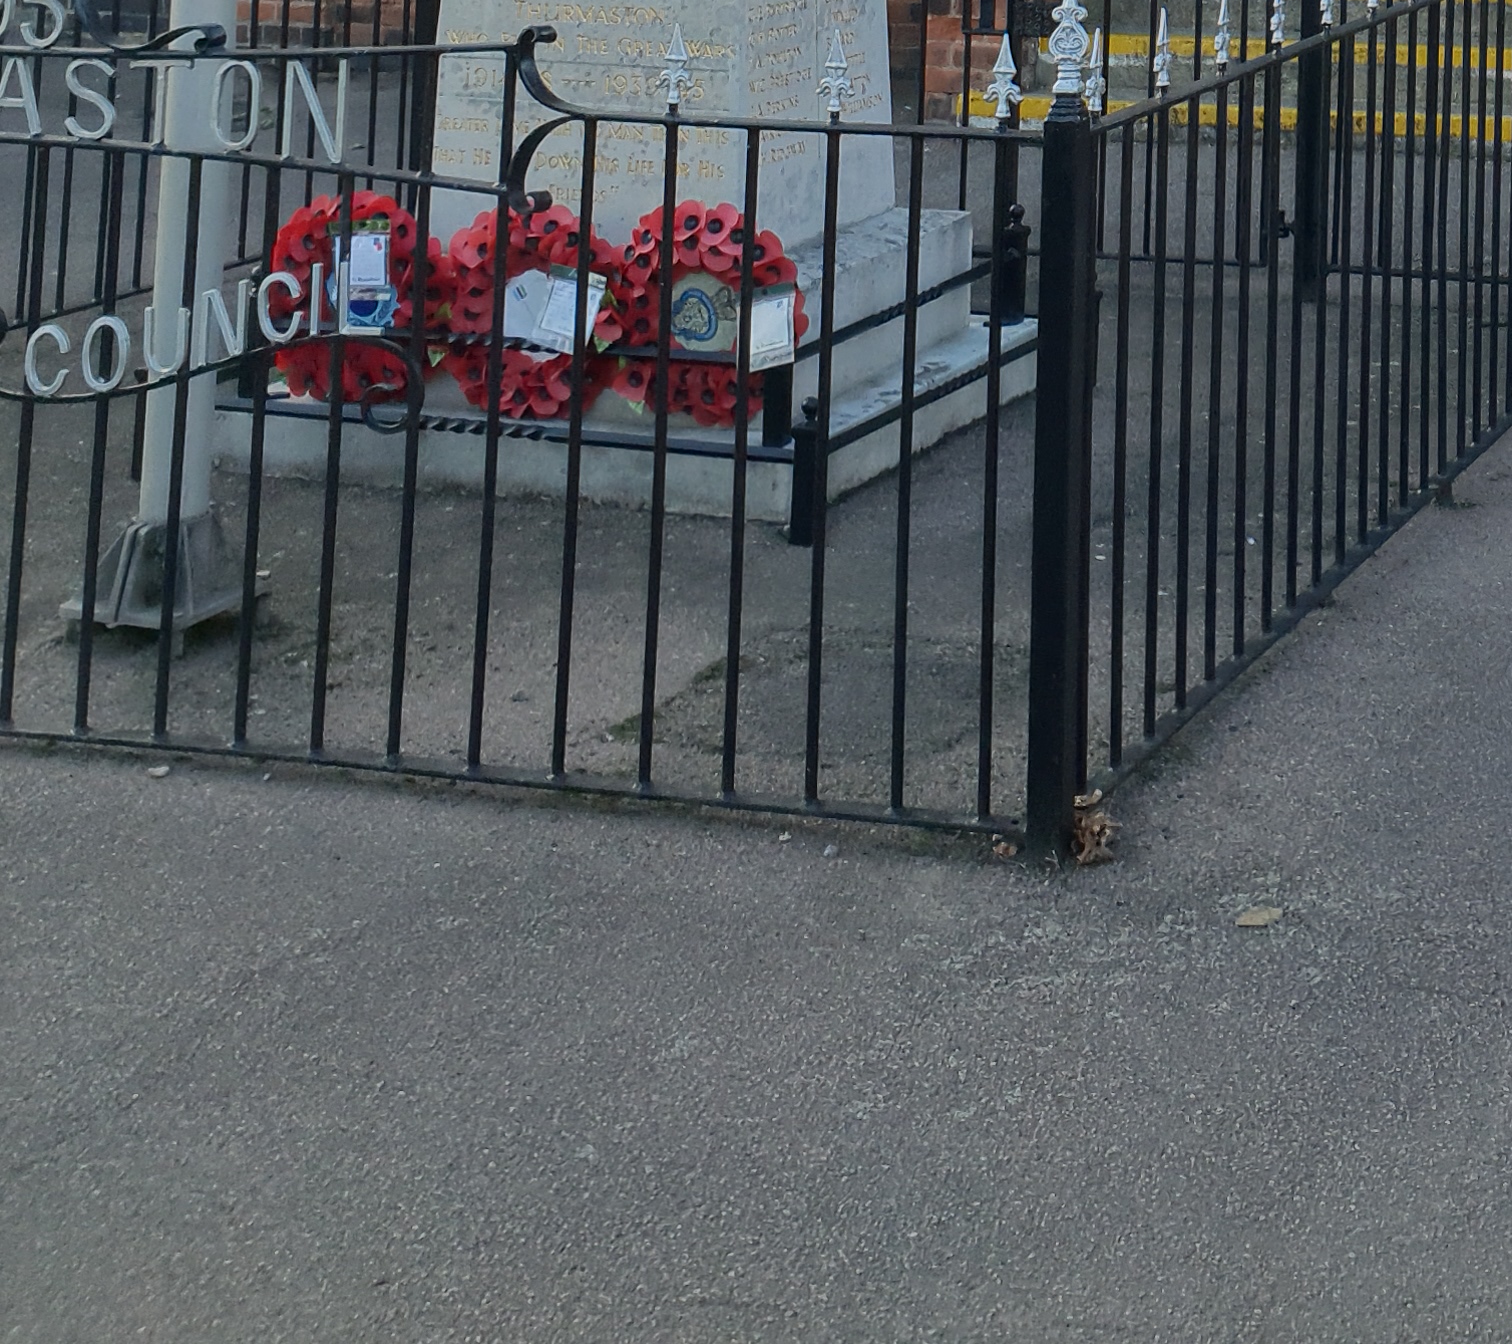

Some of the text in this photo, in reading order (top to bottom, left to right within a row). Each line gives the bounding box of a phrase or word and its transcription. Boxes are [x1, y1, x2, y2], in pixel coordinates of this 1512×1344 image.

[577, 34, 608, 55] THE
[685, 40, 737, 60] WARS
[0, 56, 349, 164] ASTON
[608, 124, 643, 140] MAN
[696, 127, 729, 145] THIS
[473, 148, 491, 165] HE
[627, 158, 654, 177] LIFE
[699, 160, 725, 179] HIS
[24, 260, 386, 399] COUNCIL
